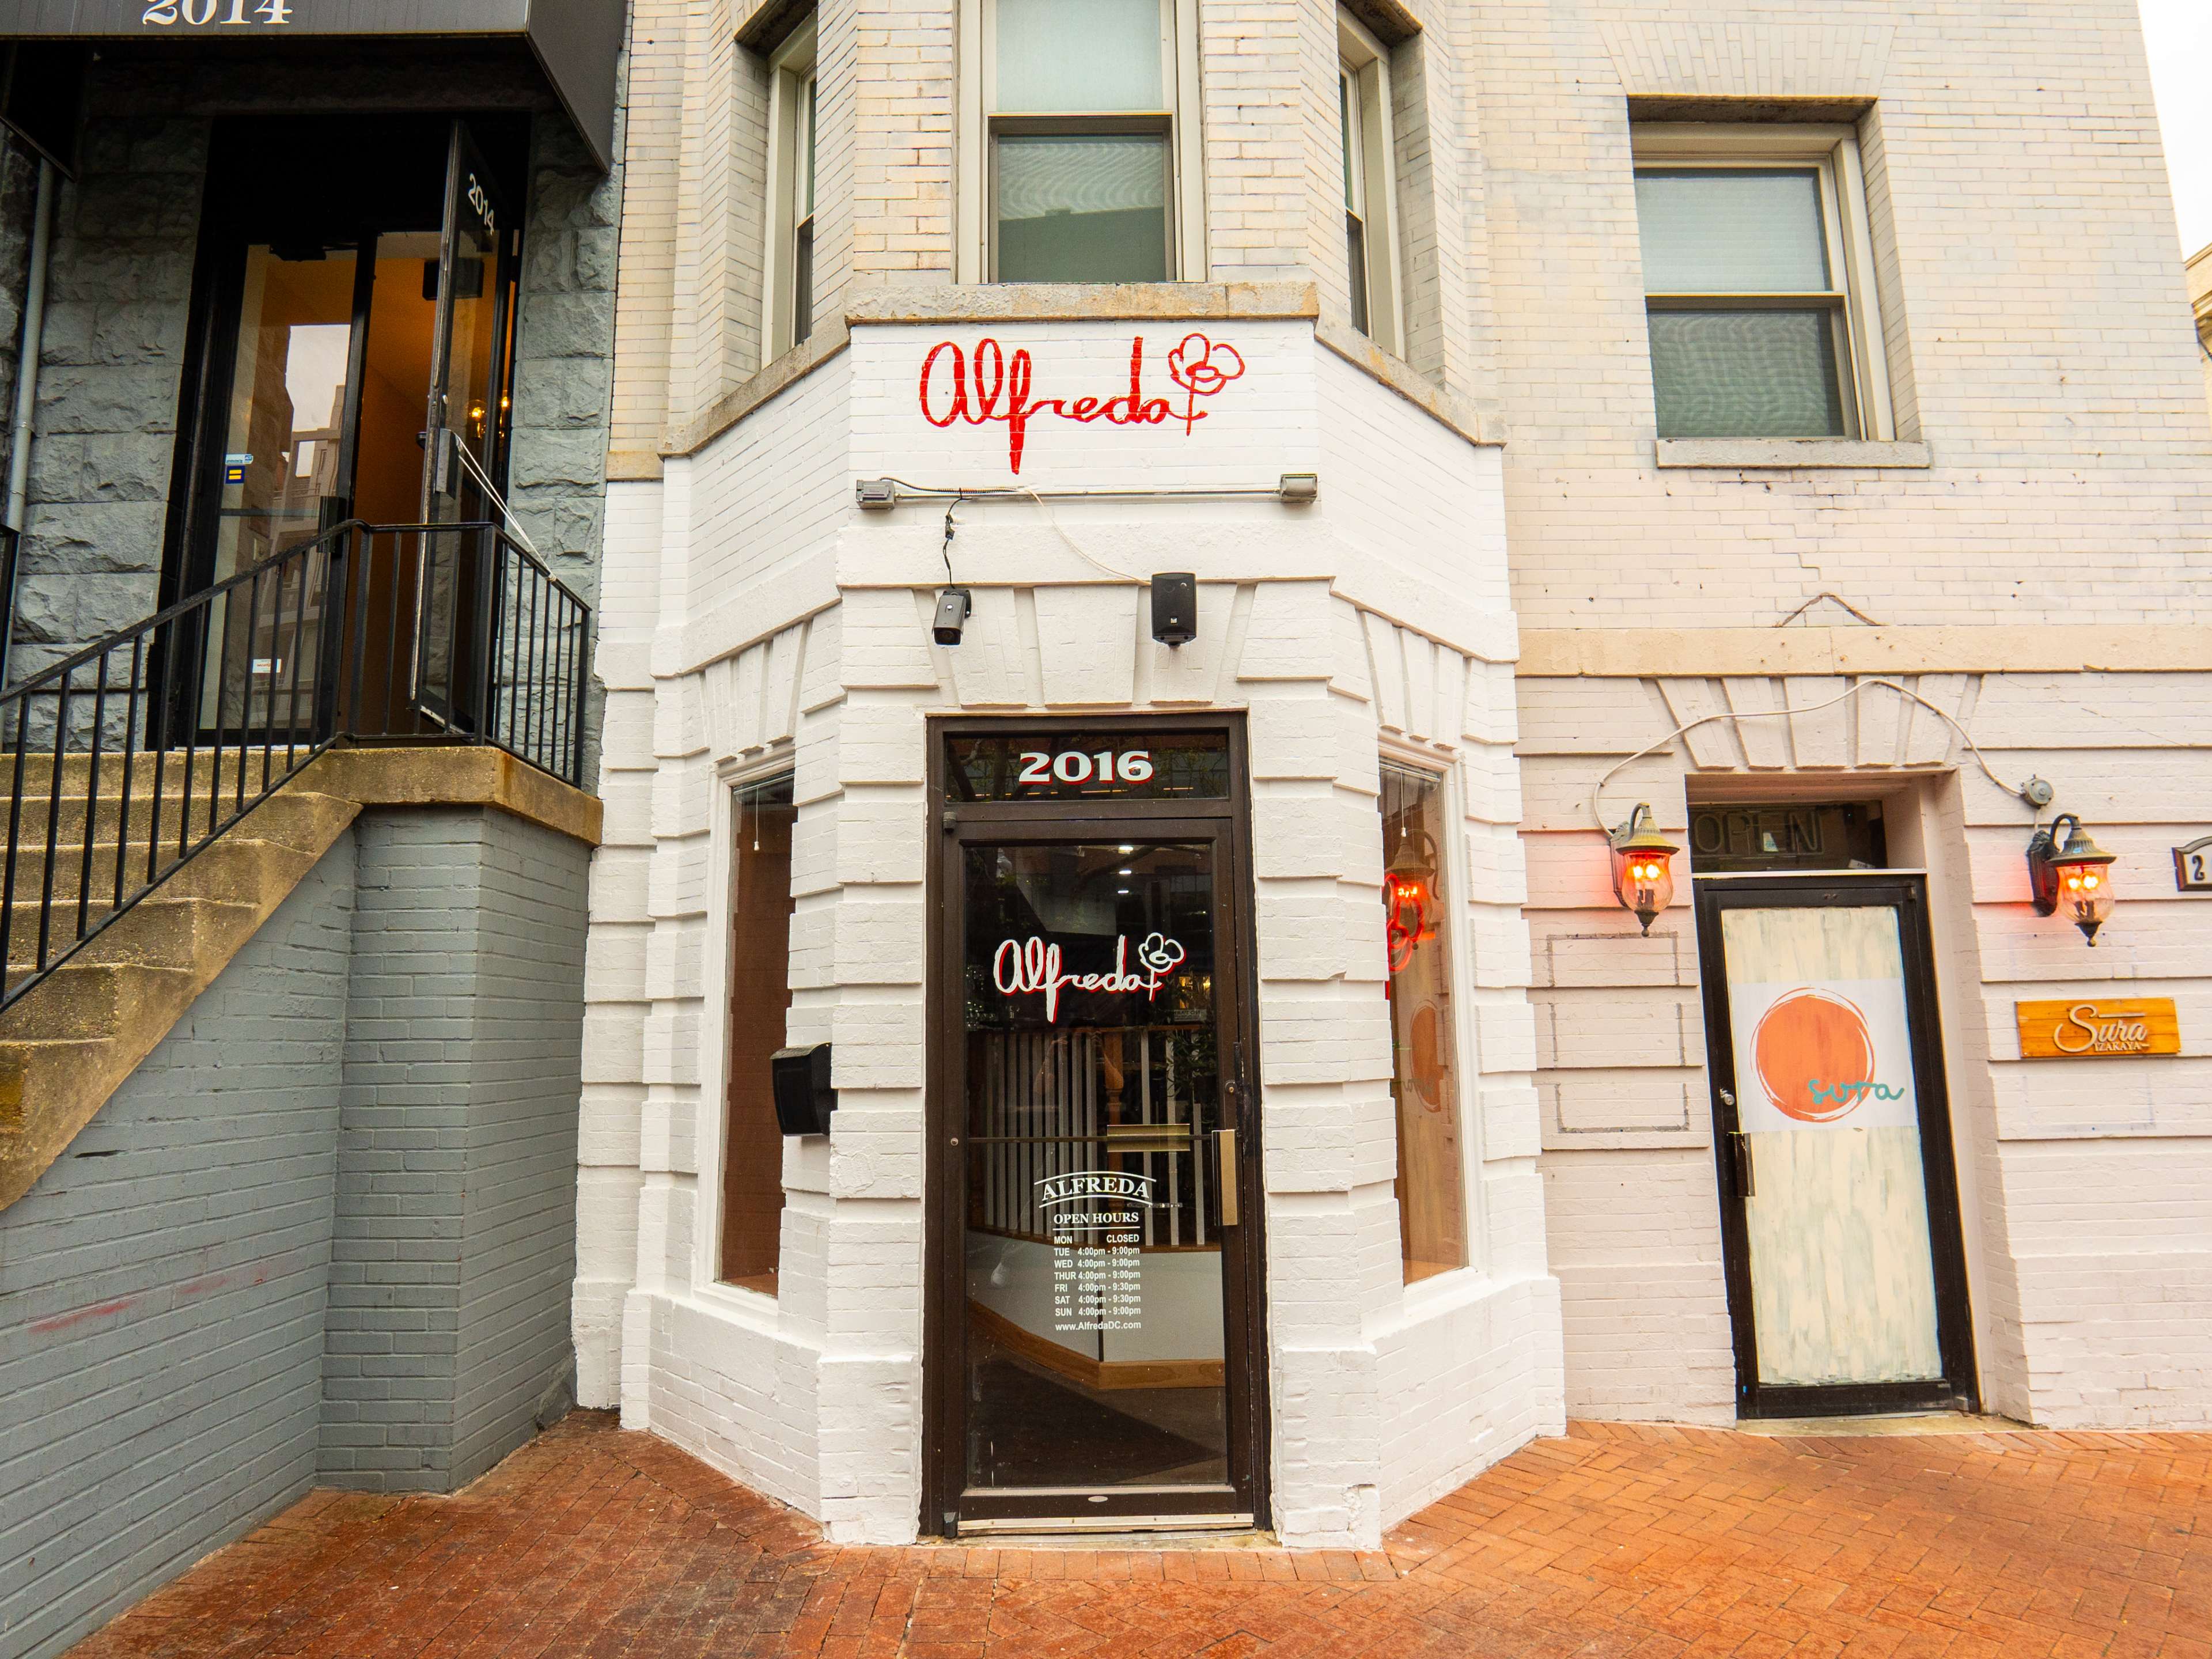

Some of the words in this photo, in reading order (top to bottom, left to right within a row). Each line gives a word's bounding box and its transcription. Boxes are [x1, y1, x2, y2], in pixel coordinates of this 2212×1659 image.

[142, 0, 293, 25] 2014
[468, 173, 494, 236] 2014
[1019, 751, 1153, 783] 2016
[1694, 811, 1819, 852] OPEN
[2054, 1004, 2147, 1052] Sura
[2094, 1042, 2142, 1052] IZAKAYA
[1041, 1177, 1149, 1201] ALFREDA
[1054, 1213, 1089, 1224] OPEN
[1092, 1212, 1139, 1224] HOURS
[1054, 1236, 1073, 1244] MON
[1107, 1234, 1139, 1243] CLOSED
[1054, 1248, 1070, 1256] TUE
[1077, 1247, 1105, 1257] 4:00pm
[1112, 1247, 1140, 1256] 9:00pm
[1054, 1260, 1073, 1268] WED
[1077, 1259, 1105, 1268] 4:00pm
[1112, 1259, 1140, 1268] 9:00pm
[1054, 1272, 1077, 1280] THUR
[1078, 1271, 1106, 1281] 4:00pm
[1113, 1270, 1141, 1280] 9:00pm
[1055, 1284, 1068, 1292] FRI
[1078, 1283, 1106, 1293] 4:00pm
[1113, 1282, 1141, 1292] 9:30pm
[1055, 1296, 1070, 1304] SAT
[1078, 1295, 1107, 1305] 4:00pm
[1113, 1294, 1141, 1304] 9:30pm
[1055, 1308, 1072, 1316] SUN
[1078, 1307, 1107, 1317] 4:00pm
[1113, 1306, 1141, 1316] 9:00pm
[1055, 1321, 1142, 1331] www.AlfredaDC.com
